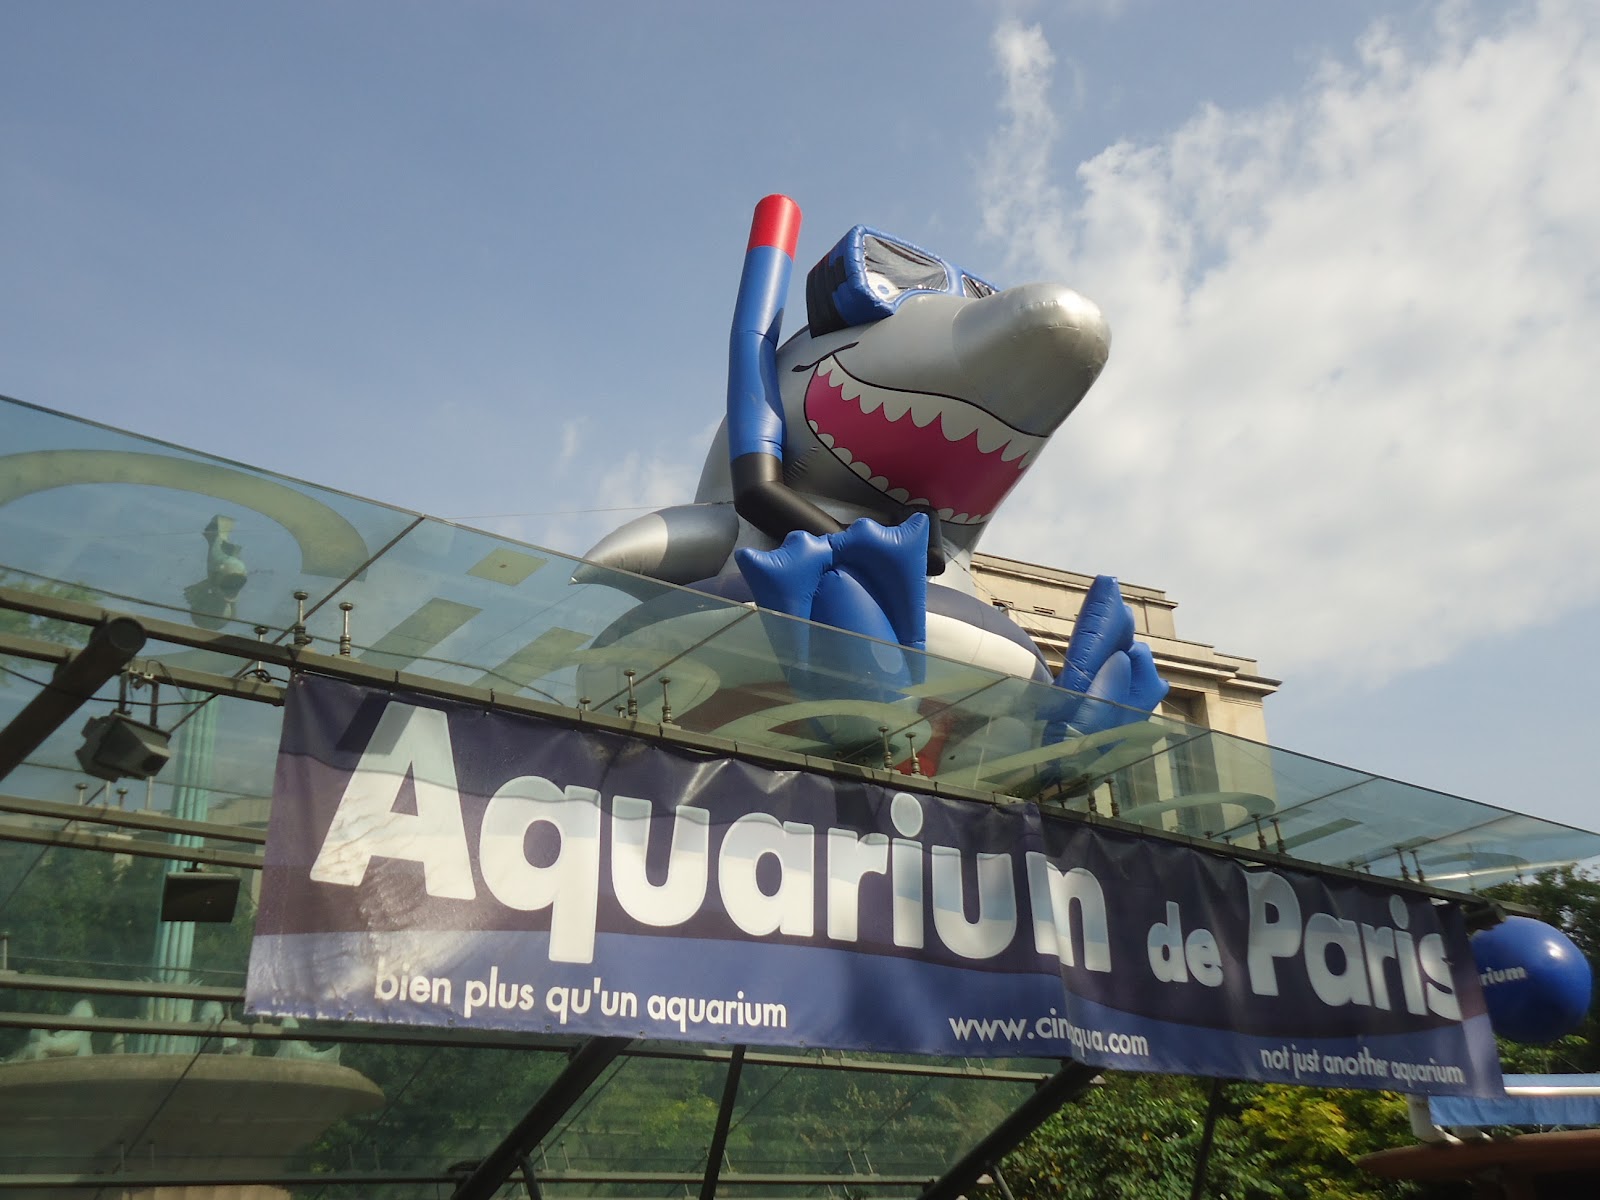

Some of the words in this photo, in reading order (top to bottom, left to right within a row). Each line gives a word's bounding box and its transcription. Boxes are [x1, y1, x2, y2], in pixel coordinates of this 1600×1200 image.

[310, 700, 1112, 973] Aquarium
[1147, 901, 1224, 987] de
[1246, 871, 1463, 1021] Paris
[374, 955, 452, 1006] bien
[463, 965, 535, 1018] plus
[546, 976, 638, 1025] qu'un
[647, 990, 788, 1033] aquarium
[1260, 1044, 1291, 1070] not
[1292, 1044, 1321, 1080] just
[1322, 1046, 1389, 1078] another
[1391, 1057, 1468, 1088] aquarium
